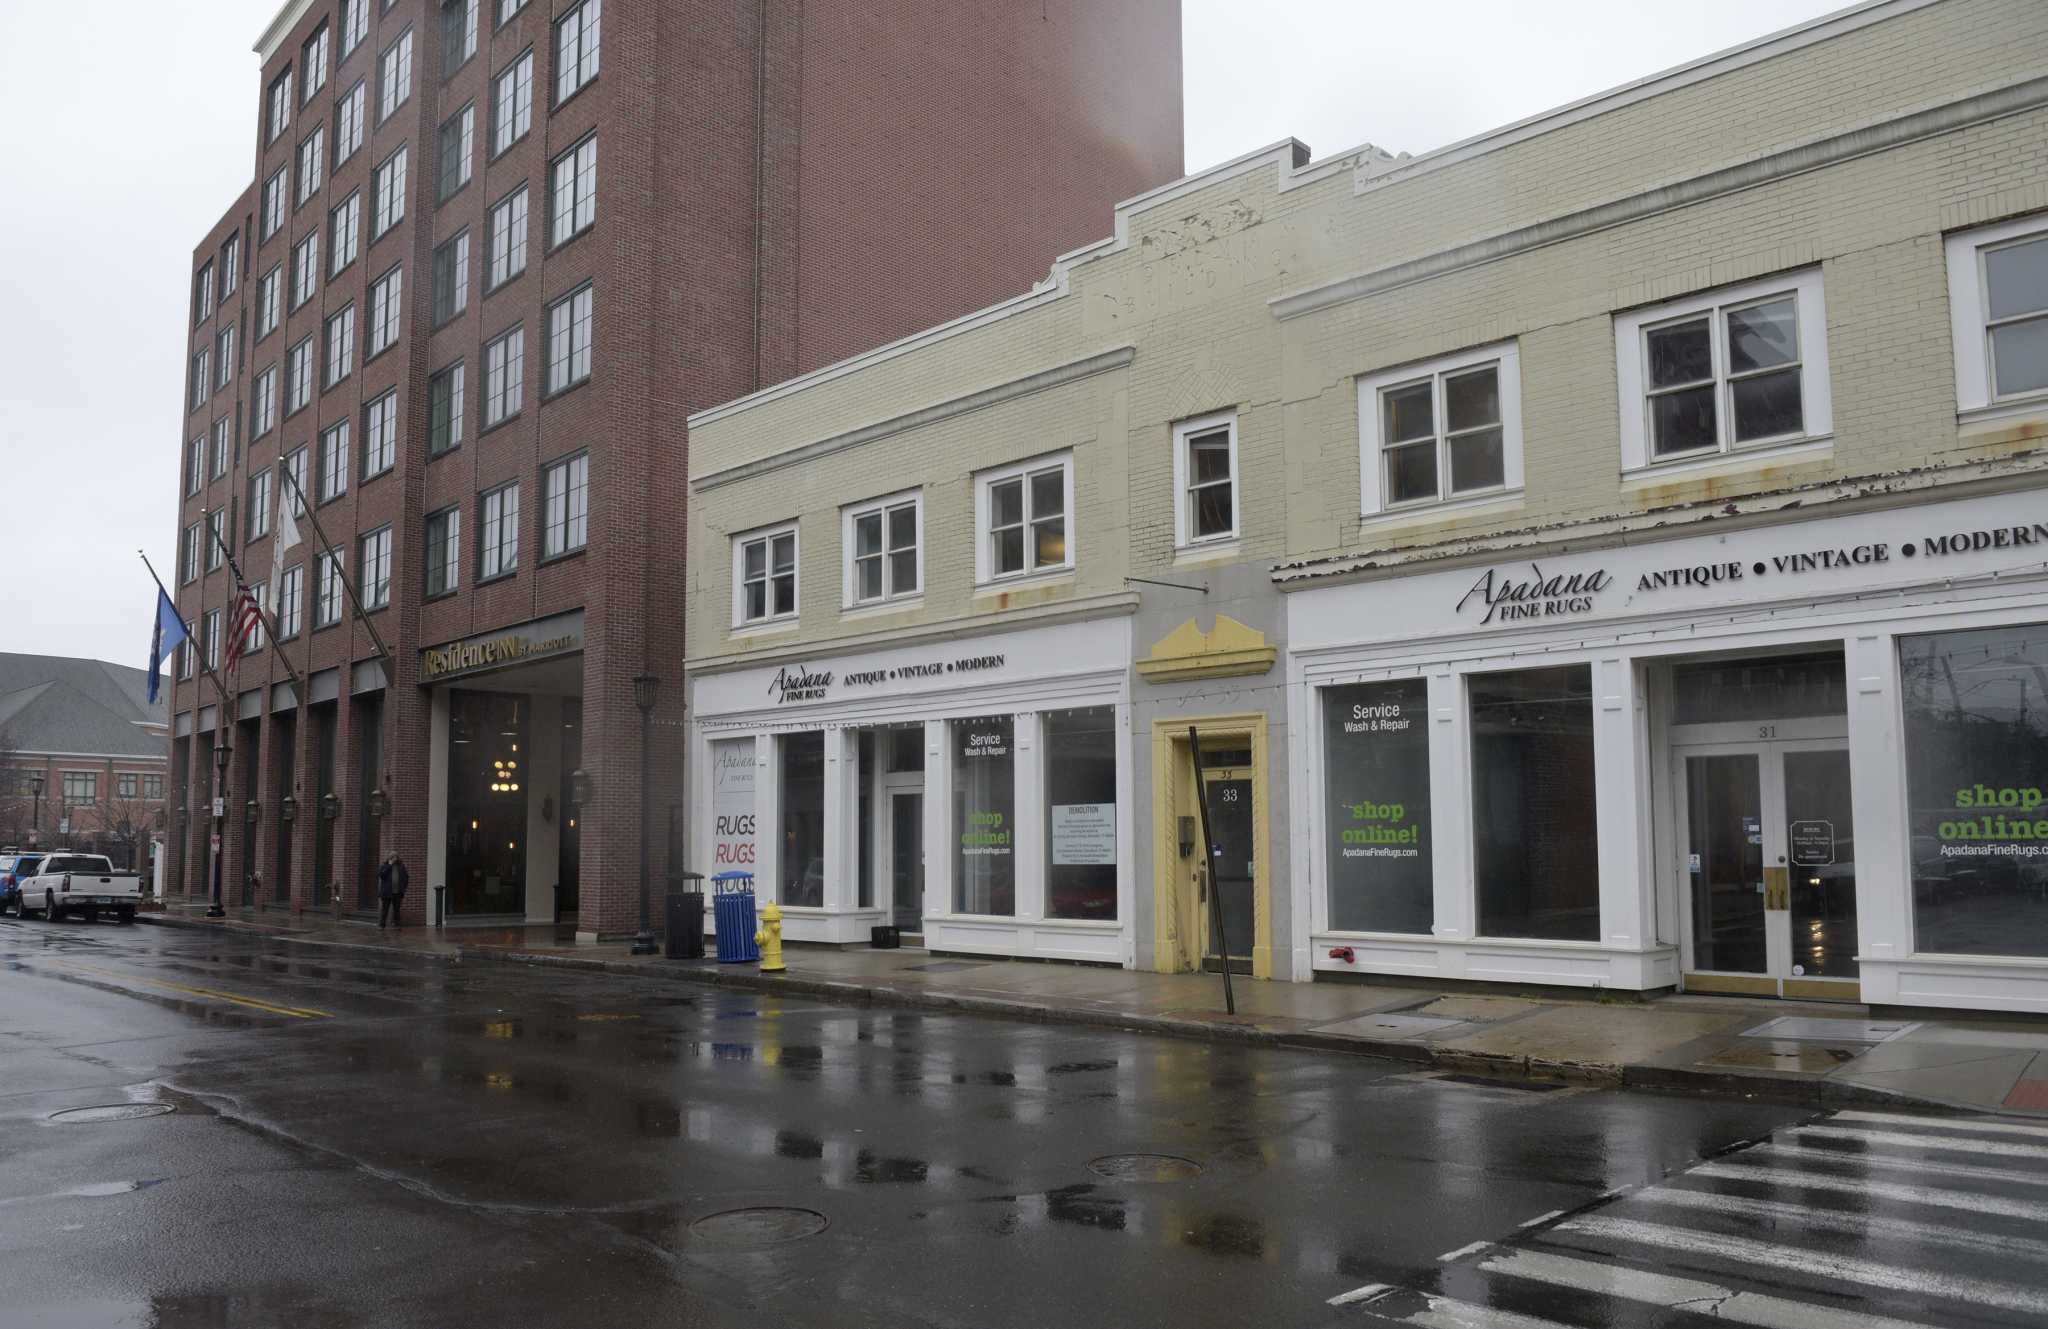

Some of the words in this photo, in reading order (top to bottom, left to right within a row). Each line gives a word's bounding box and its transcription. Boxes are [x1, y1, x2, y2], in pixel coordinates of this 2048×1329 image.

[1637, 561, 1743, 591] ANTIQUE
[1772, 543, 1889, 574] VINTAGE
[1924, 523, 2048, 556] MODERN
[1456, 562, 1613, 624] Apadana
[1500, 602, 1540, 620] FINE
[1544, 596, 1593, 615] RUGS
[424, 639, 495, 676] Residence
[843, 670, 886, 687] ANTIQUE
[898, 662, 943, 679] VINTAGE
[955, 654, 1005, 672] MODERN
[767, 664, 835, 704] Apadana
[786, 689, 804, 702] FINE
[805, 688, 826, 700] RUGS
[1353, 703, 1400, 719] Service
[1344, 721, 1368, 732] Wash
[1371, 720, 1378, 731] &
[1380, 718, 1410, 732] Repair
[1759, 726, 1776, 738] 31
[970, 733, 1000, 746] Service
[964, 747, 980, 757] Wash
[981, 746, 987, 756] &
[987, 745, 1007, 756] Repair
[1220, 769, 1232, 779] 33
[1223, 788, 1238, 802] 33
[1956, 784, 2042, 811] shop
[970, 811, 1003, 828] shop
[1352, 801, 1404, 822] shop
[715, 815, 755, 836] RUGS
[1342, 824, 1418, 844] online!
[715, 843, 755, 864] RUGS
[1342, 848, 1418, 858] ApadanaFineRugs.com
